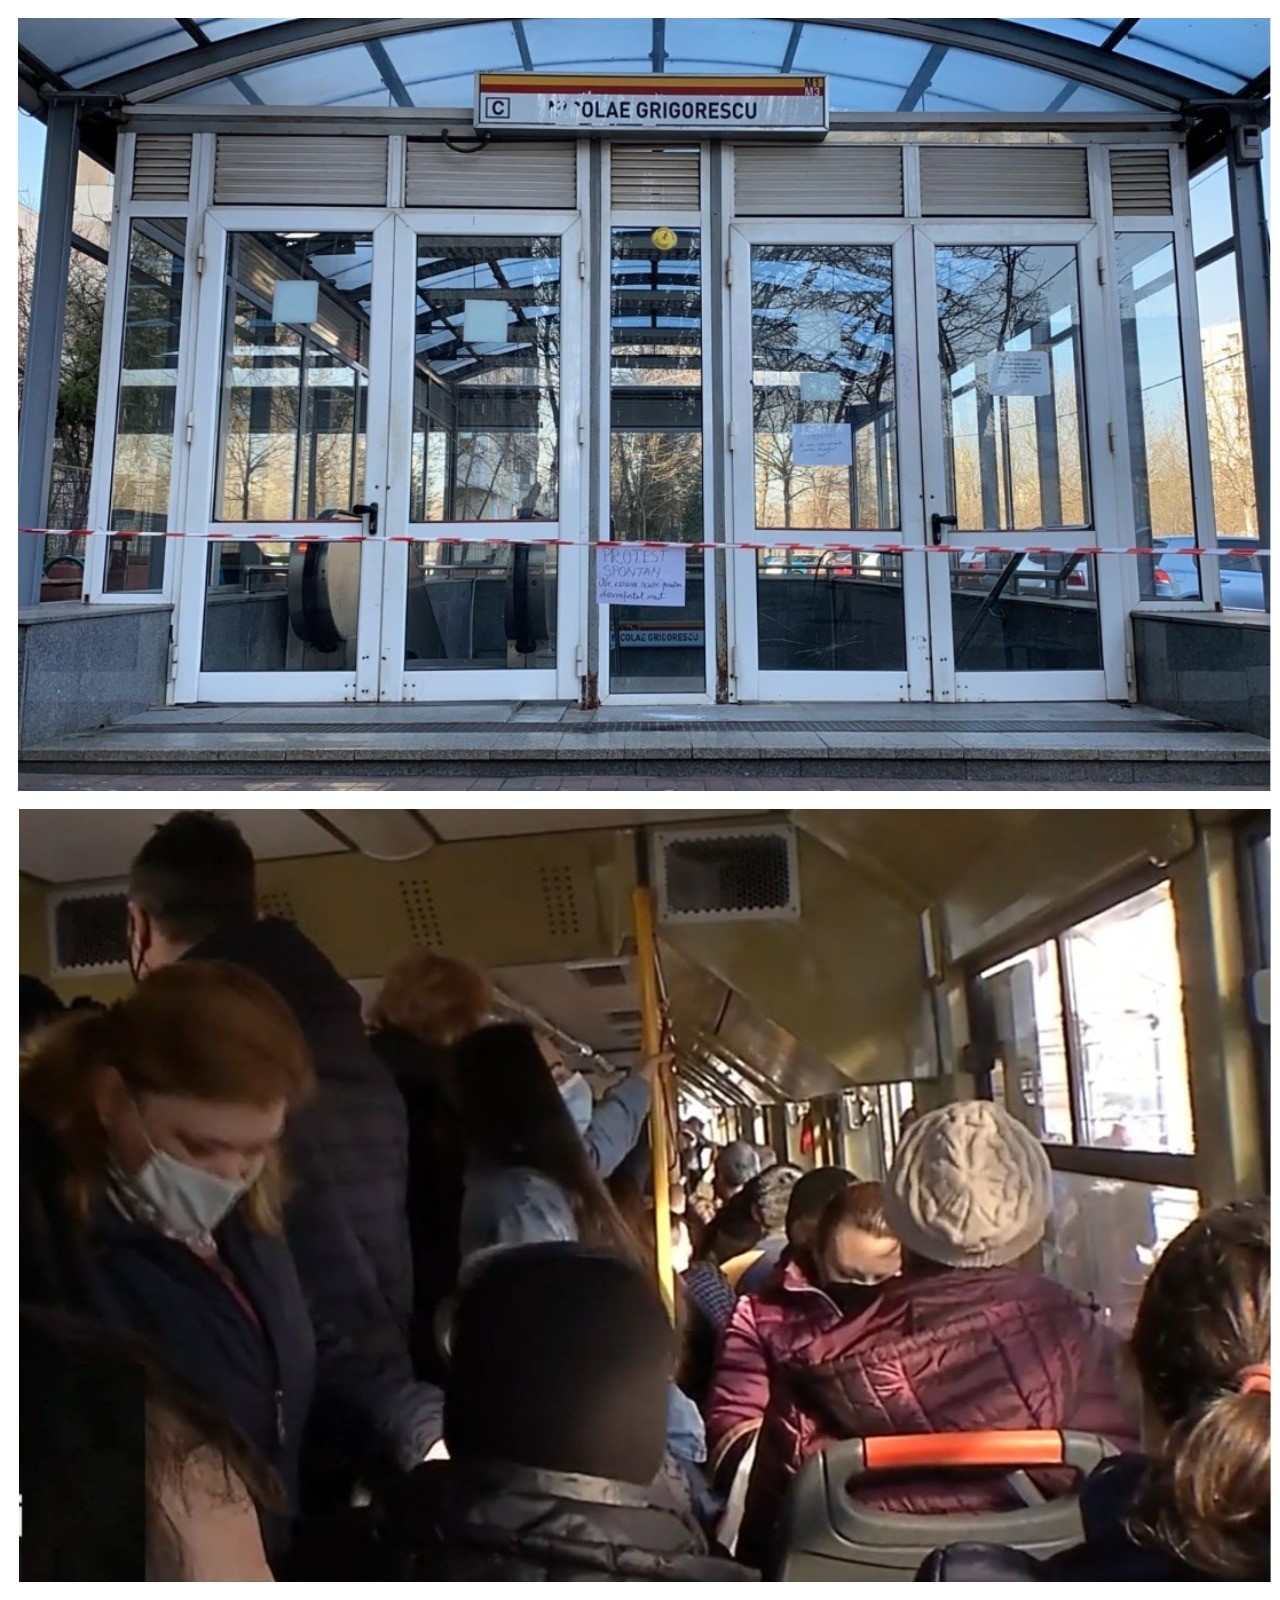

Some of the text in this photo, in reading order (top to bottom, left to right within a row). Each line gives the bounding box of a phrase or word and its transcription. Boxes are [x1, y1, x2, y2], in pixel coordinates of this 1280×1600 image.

[805, 78, 820, 87] M1
[805, 87, 820, 96] M3
[491, 101, 505, 116] C
[636, 101, 757, 119] GRIGORESCU
[603, 548, 665, 564] PROTEST
[603, 565, 661, 578] SPONTAN
